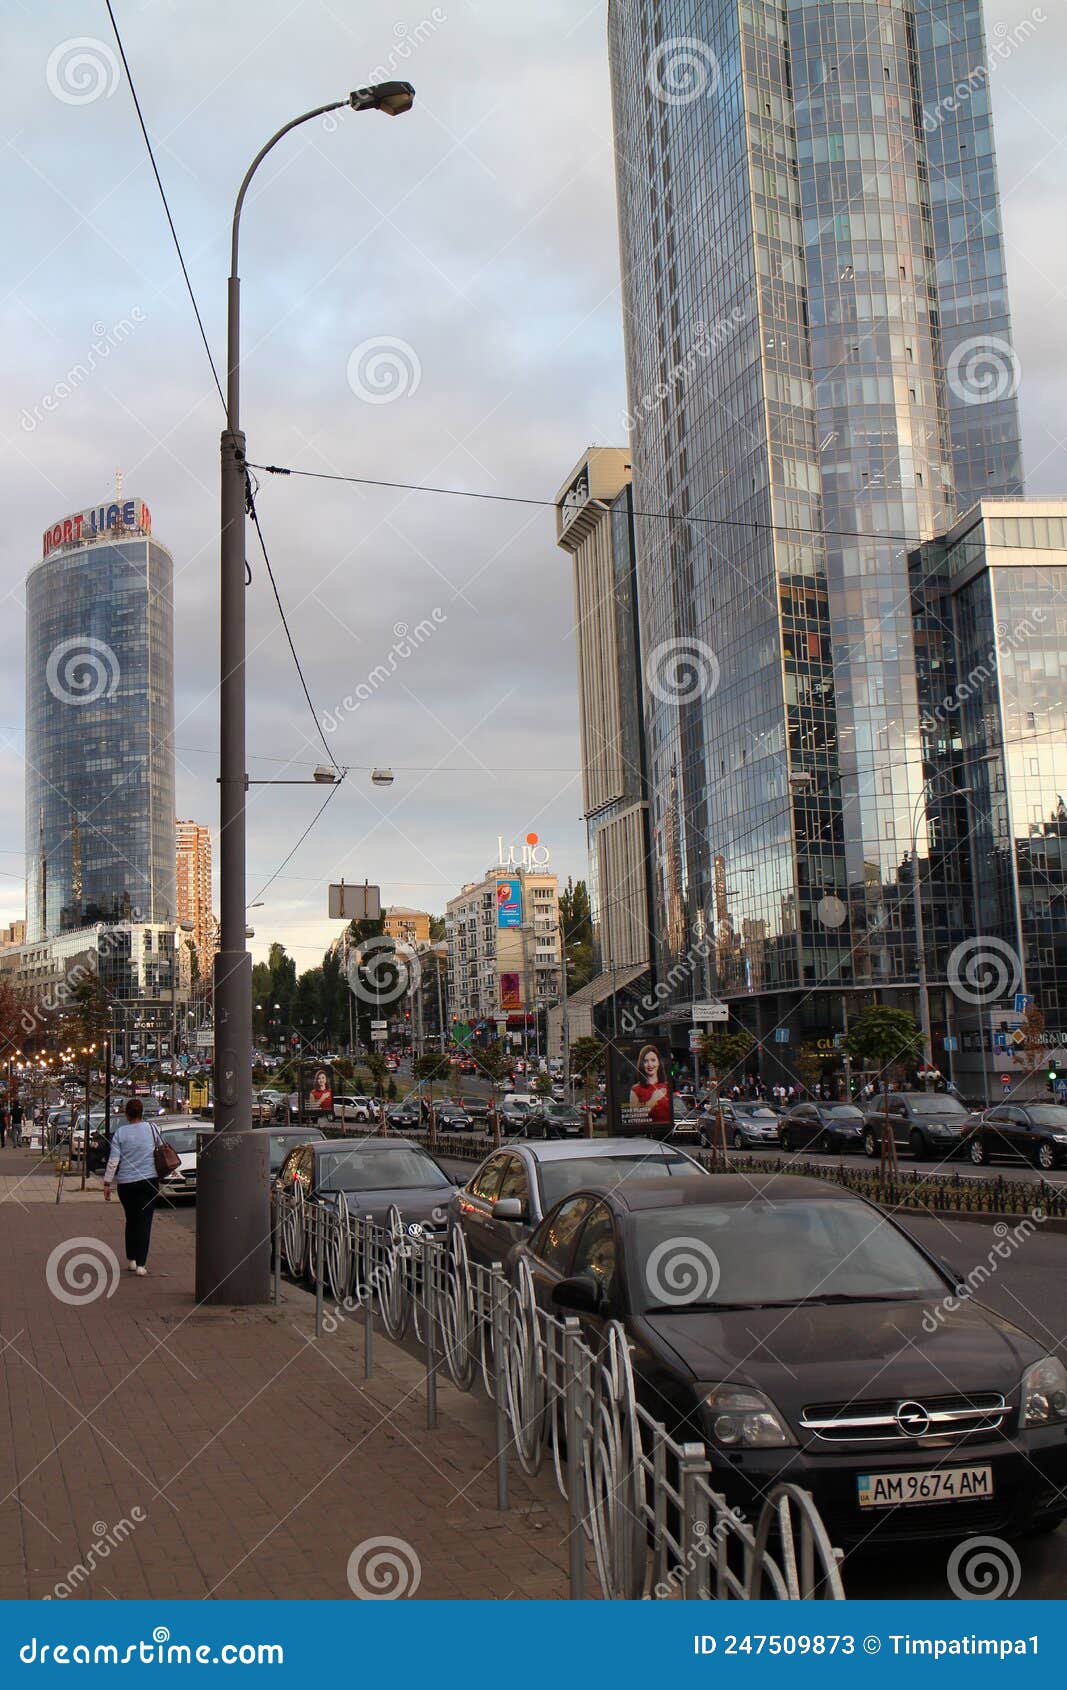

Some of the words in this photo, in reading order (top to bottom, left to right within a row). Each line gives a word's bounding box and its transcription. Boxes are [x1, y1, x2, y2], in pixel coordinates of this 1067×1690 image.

[497, 833, 550, 873] Lujo
[874, 1478, 903, 1500] AM
[907, 1473, 954, 1498] 9674
[960, 1471, 988, 1494] AM
